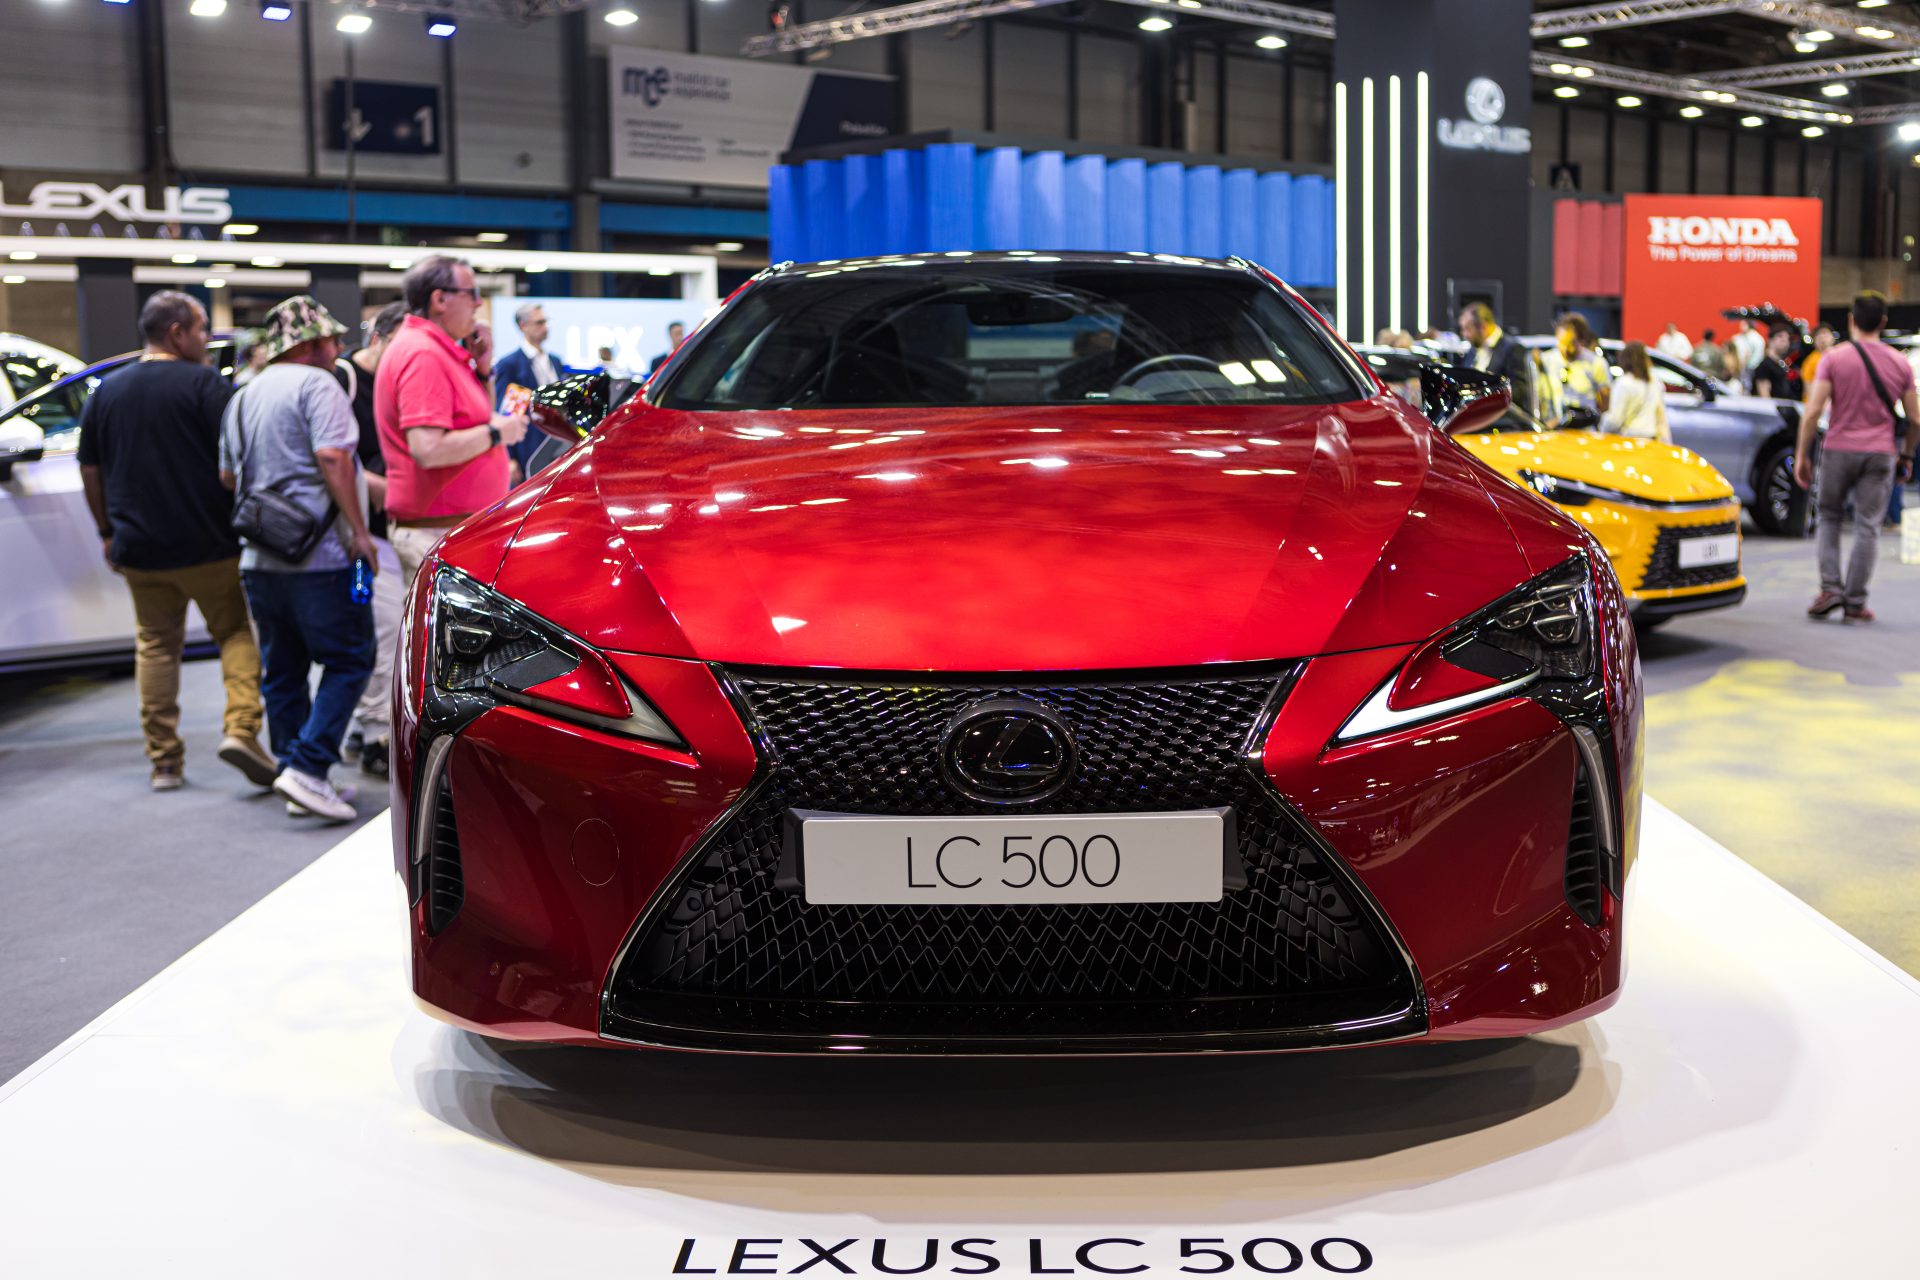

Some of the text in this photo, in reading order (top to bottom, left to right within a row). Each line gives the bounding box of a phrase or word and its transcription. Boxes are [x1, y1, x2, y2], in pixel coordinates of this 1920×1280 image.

[413, 106, 435, 147] 1
[1437, 117, 1531, 153] LEXUS
[0, 179, 233, 224] LEXUS
[1647, 216, 1799, 246] HONDA
[1648, 244, 1798, 263] The Power of Dreams
[907, 834, 1121, 889] LC 500
[672, 1237, 1373, 1275] LEXUS LC 500
